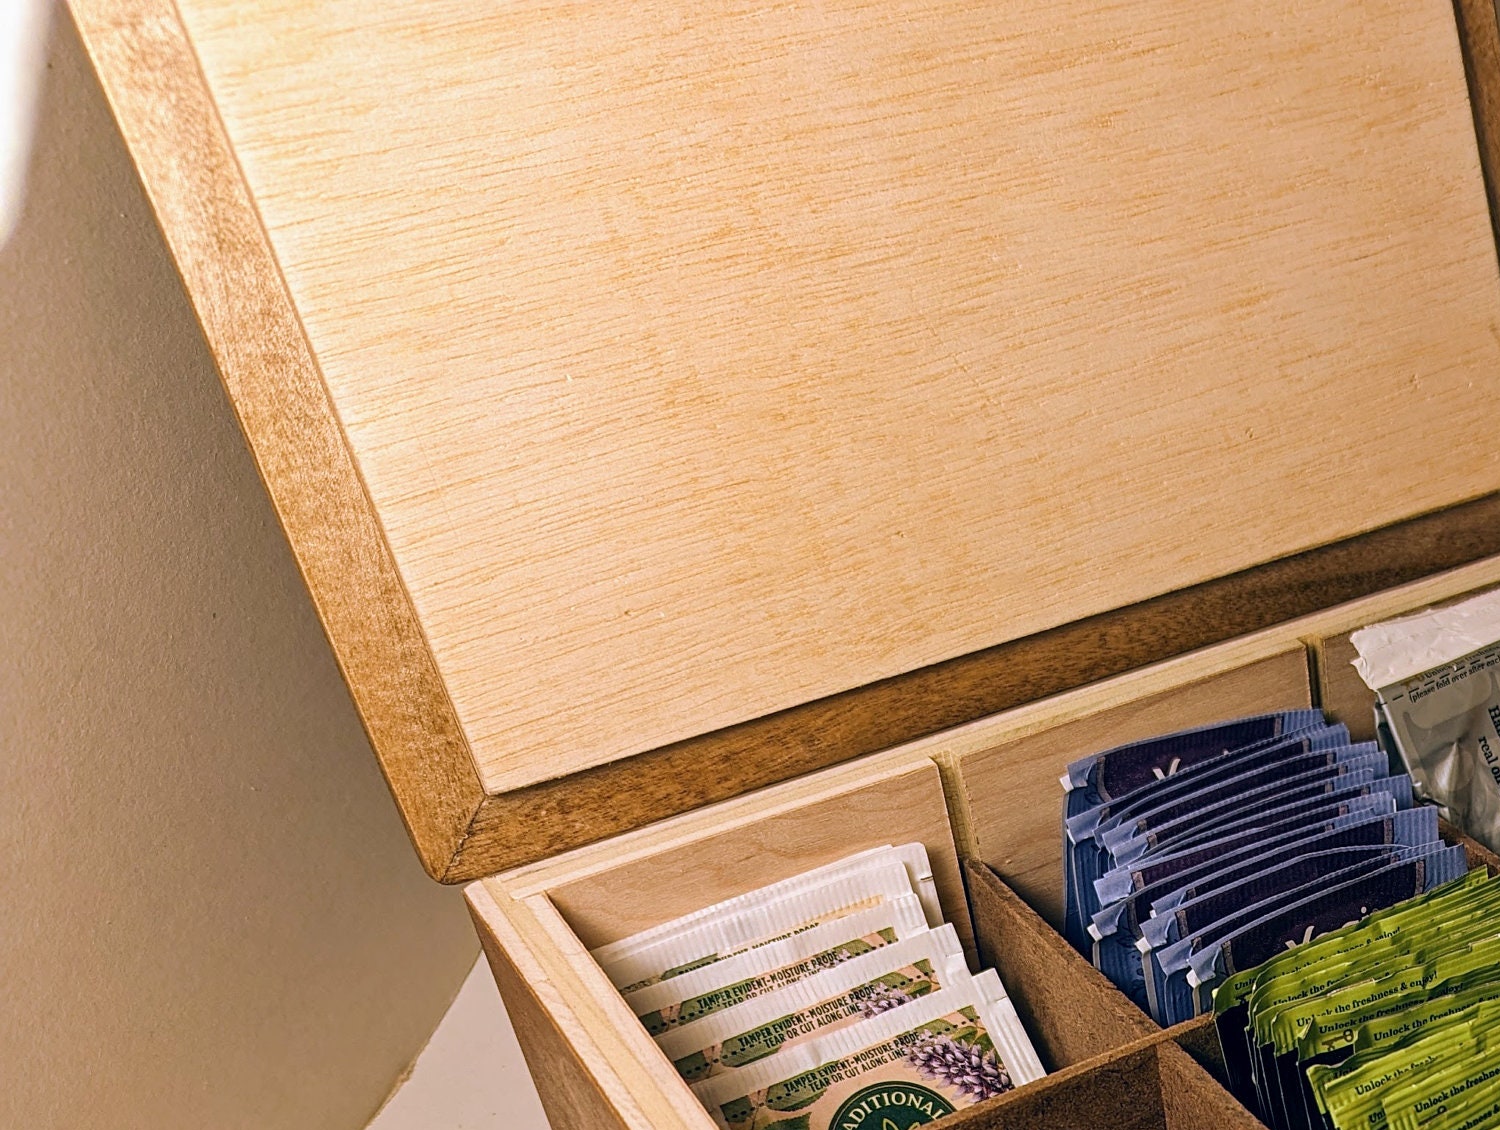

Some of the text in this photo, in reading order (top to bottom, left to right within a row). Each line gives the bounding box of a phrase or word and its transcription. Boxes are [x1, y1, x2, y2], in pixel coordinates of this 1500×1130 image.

[1435, 677, 1451, 690] fold
[1451, 670, 1468, 683] over
[1475, 735, 1499, 765] real
[696, 989, 733, 1010] TAMPER
[731, 961, 811, 1000] EVIDENT-MOISTURE
[1334, 1003, 1351, 1014] the
[1351, 986, 1399, 1009] freshness
[1399, 981, 1409, 991] &
[1409, 969, 1438, 988] enjoy!
[736, 983, 876, 1047] TAMPER EVIDENT-MOISTURE PROOF
[762, 1001, 863, 1049] TEAR OR CUT ALONG LINE
[1315, 1013, 1359, 1037] Unlock
[1358, 1013, 1375, 1024] the
[1373, 1023, 1411, 1042] Unlock
[782, 1030, 920, 1093] TAMPER EVIDENT-MOISTURE PROOF
[807, 1046, 909, 1093] TEAR OR CUT ALONG LINE
[1413, 1091, 1450, 1113] Unlock
[1449, 1084, 1468, 1097] the
